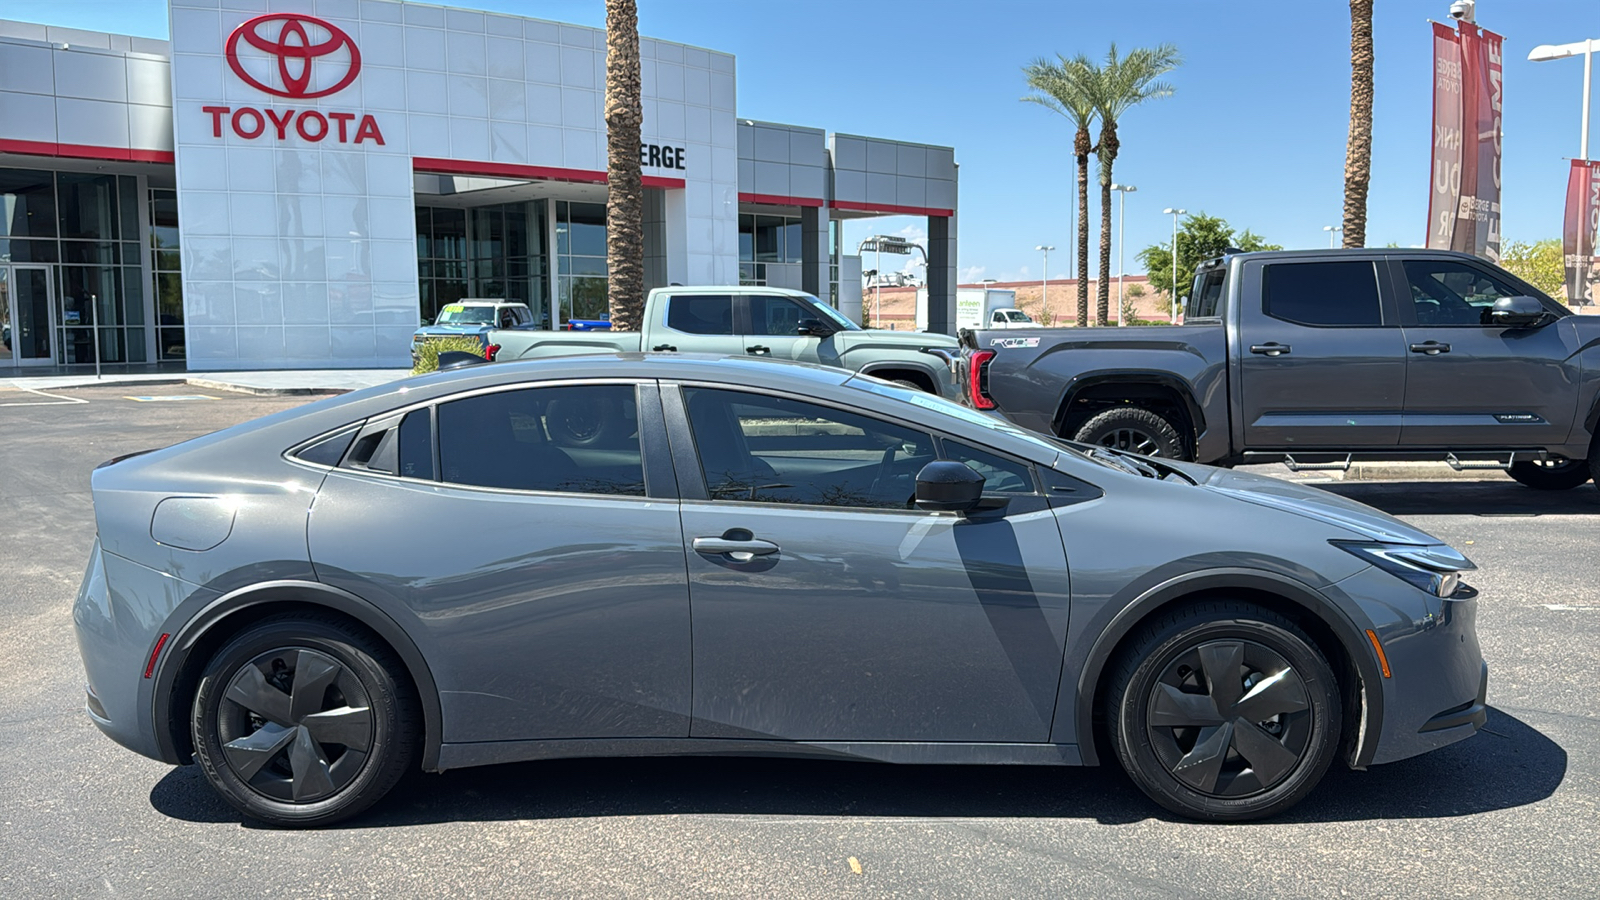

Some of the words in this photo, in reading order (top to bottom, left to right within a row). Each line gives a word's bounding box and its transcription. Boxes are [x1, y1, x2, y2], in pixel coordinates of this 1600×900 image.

[203, 106, 386, 146] TOYOTA
[639, 143, 686, 170] ERGE
[1470, 195, 1490, 212] BERGE
[1469, 211, 1488, 223] TOYOTA
[958, 299, 981, 307] anteen
[196, 715, 221, 783] EXTENSA
